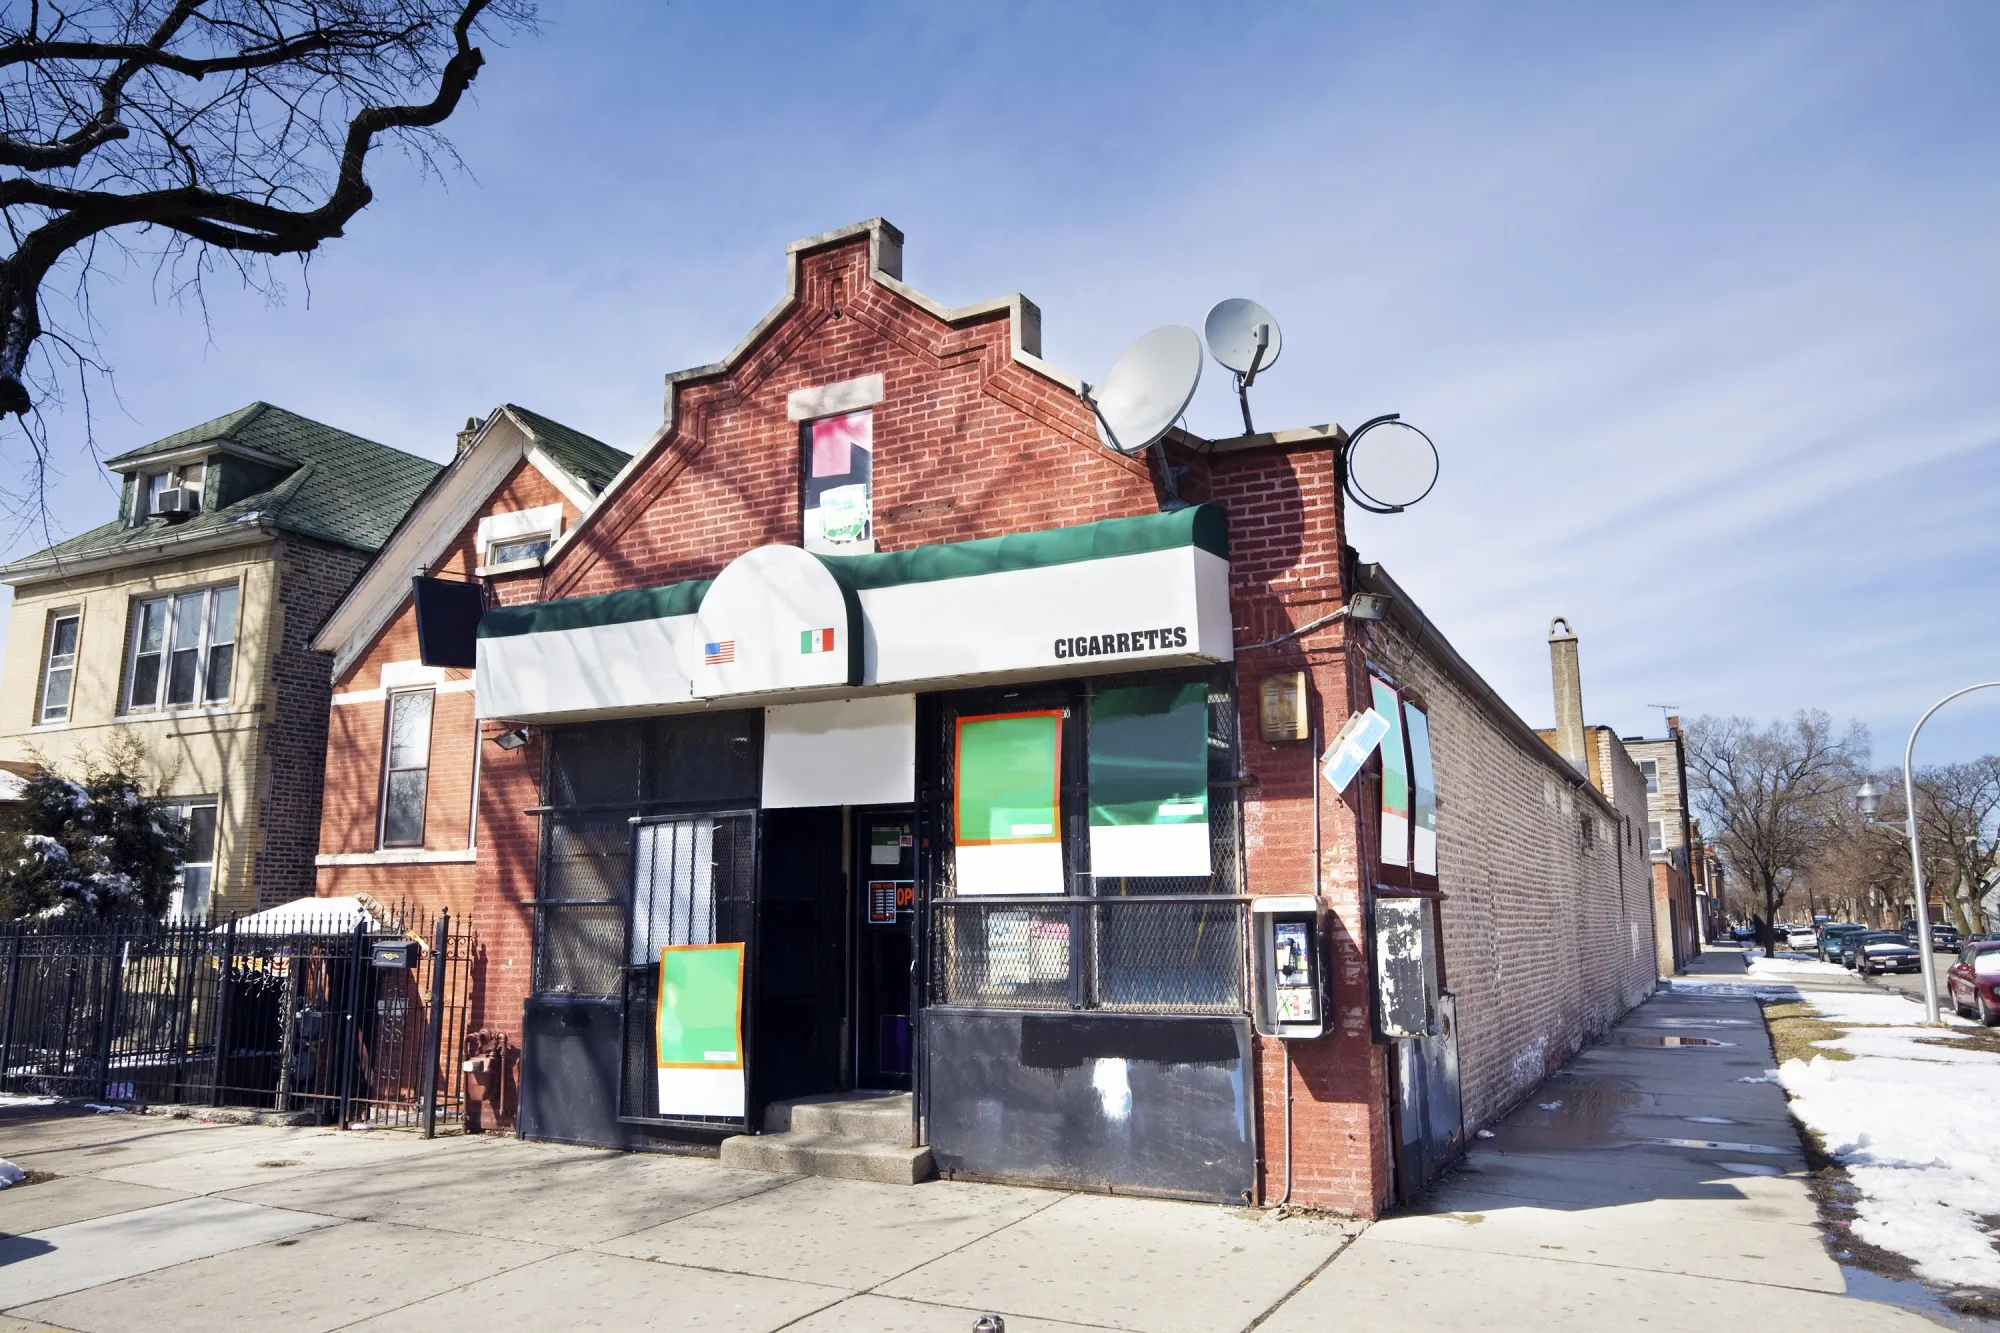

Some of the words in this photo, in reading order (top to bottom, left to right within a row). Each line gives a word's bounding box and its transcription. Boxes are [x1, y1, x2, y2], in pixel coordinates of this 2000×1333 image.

[1054, 626, 1187, 659] CIGARRETES
[897, 888, 924, 906] OP
[1268, 900, 1301, 908] Phone
